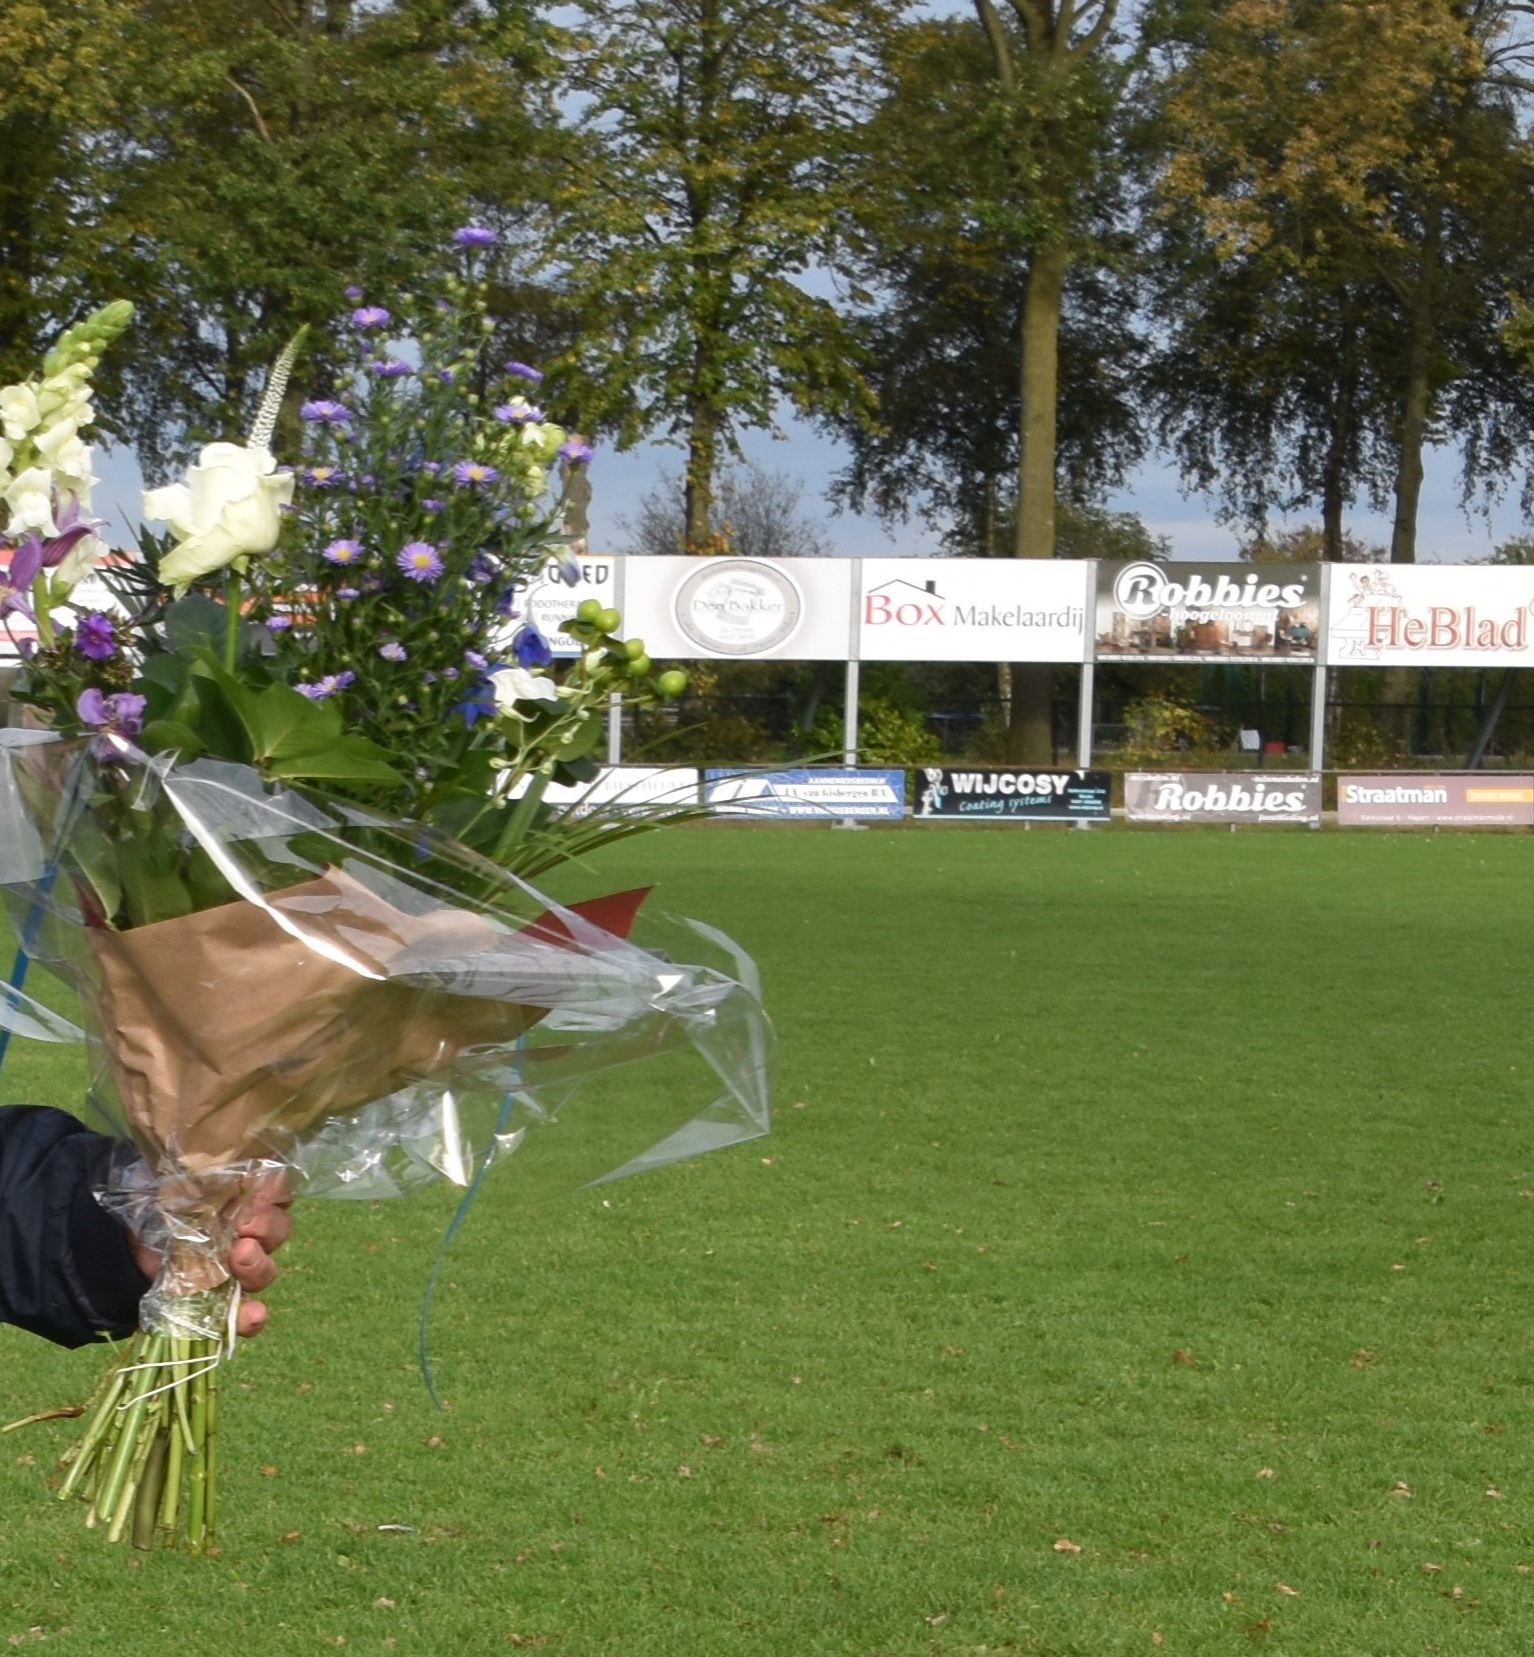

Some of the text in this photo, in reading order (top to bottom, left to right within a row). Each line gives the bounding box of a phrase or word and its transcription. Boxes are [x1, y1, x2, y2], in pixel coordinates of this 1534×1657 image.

[1114, 562, 1308, 618] Robbies
[864, 594, 1084, 636] Box Makelaardij
[1366, 604, 1529, 652] HeBlad
[950, 773, 1070, 795] WIJCOSY
[1154, 783, 1307, 812] Robbies
[1346, 784, 1448, 804] Straatman
[959, 799, 1005, 814] Coating
[1008, 795, 1053, 813] systems
